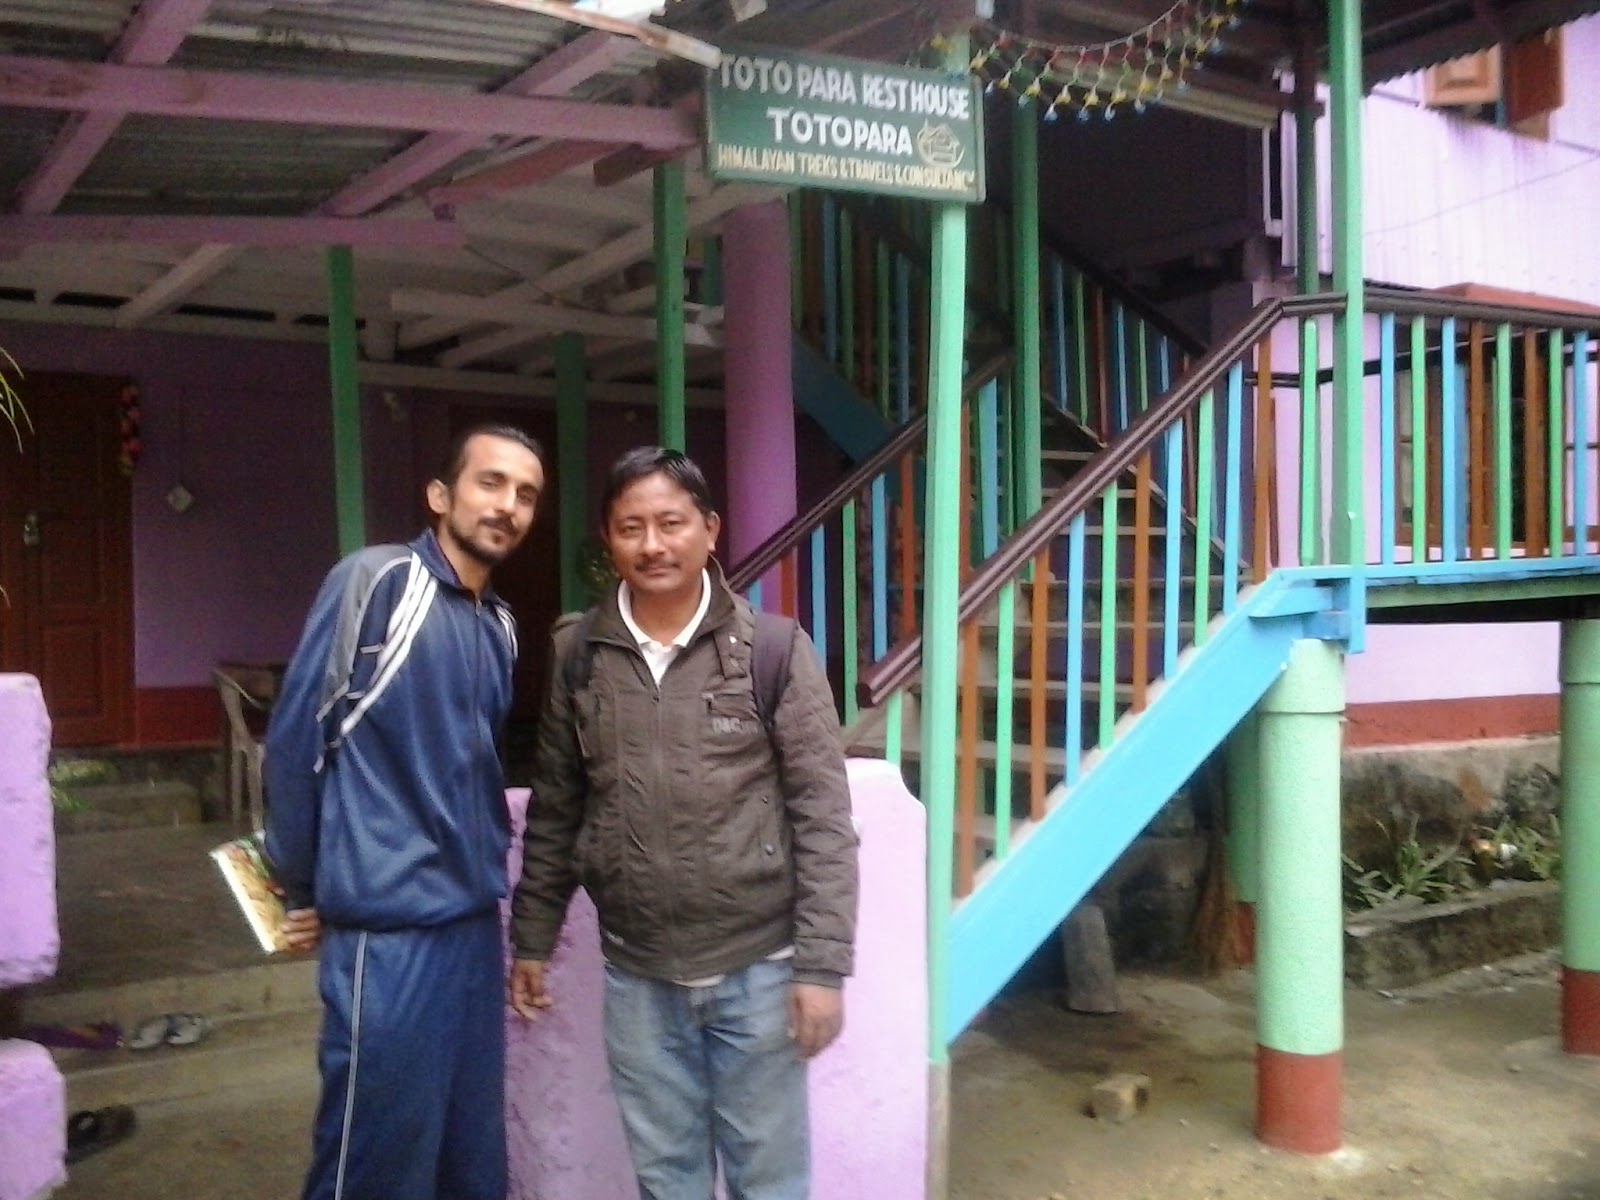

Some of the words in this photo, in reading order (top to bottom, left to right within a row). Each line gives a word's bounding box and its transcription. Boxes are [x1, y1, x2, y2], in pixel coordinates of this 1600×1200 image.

[719, 53, 793, 94] TOTO
[797, 64, 857, 105] PARA
[863, 73, 908, 112] REST
[910, 79, 970, 120] HOUSE
[766, 106, 913, 154] TOTOPARA
[718, 144, 795, 173] HIMALAYAN
[799, 152, 838, 179] TREKS
